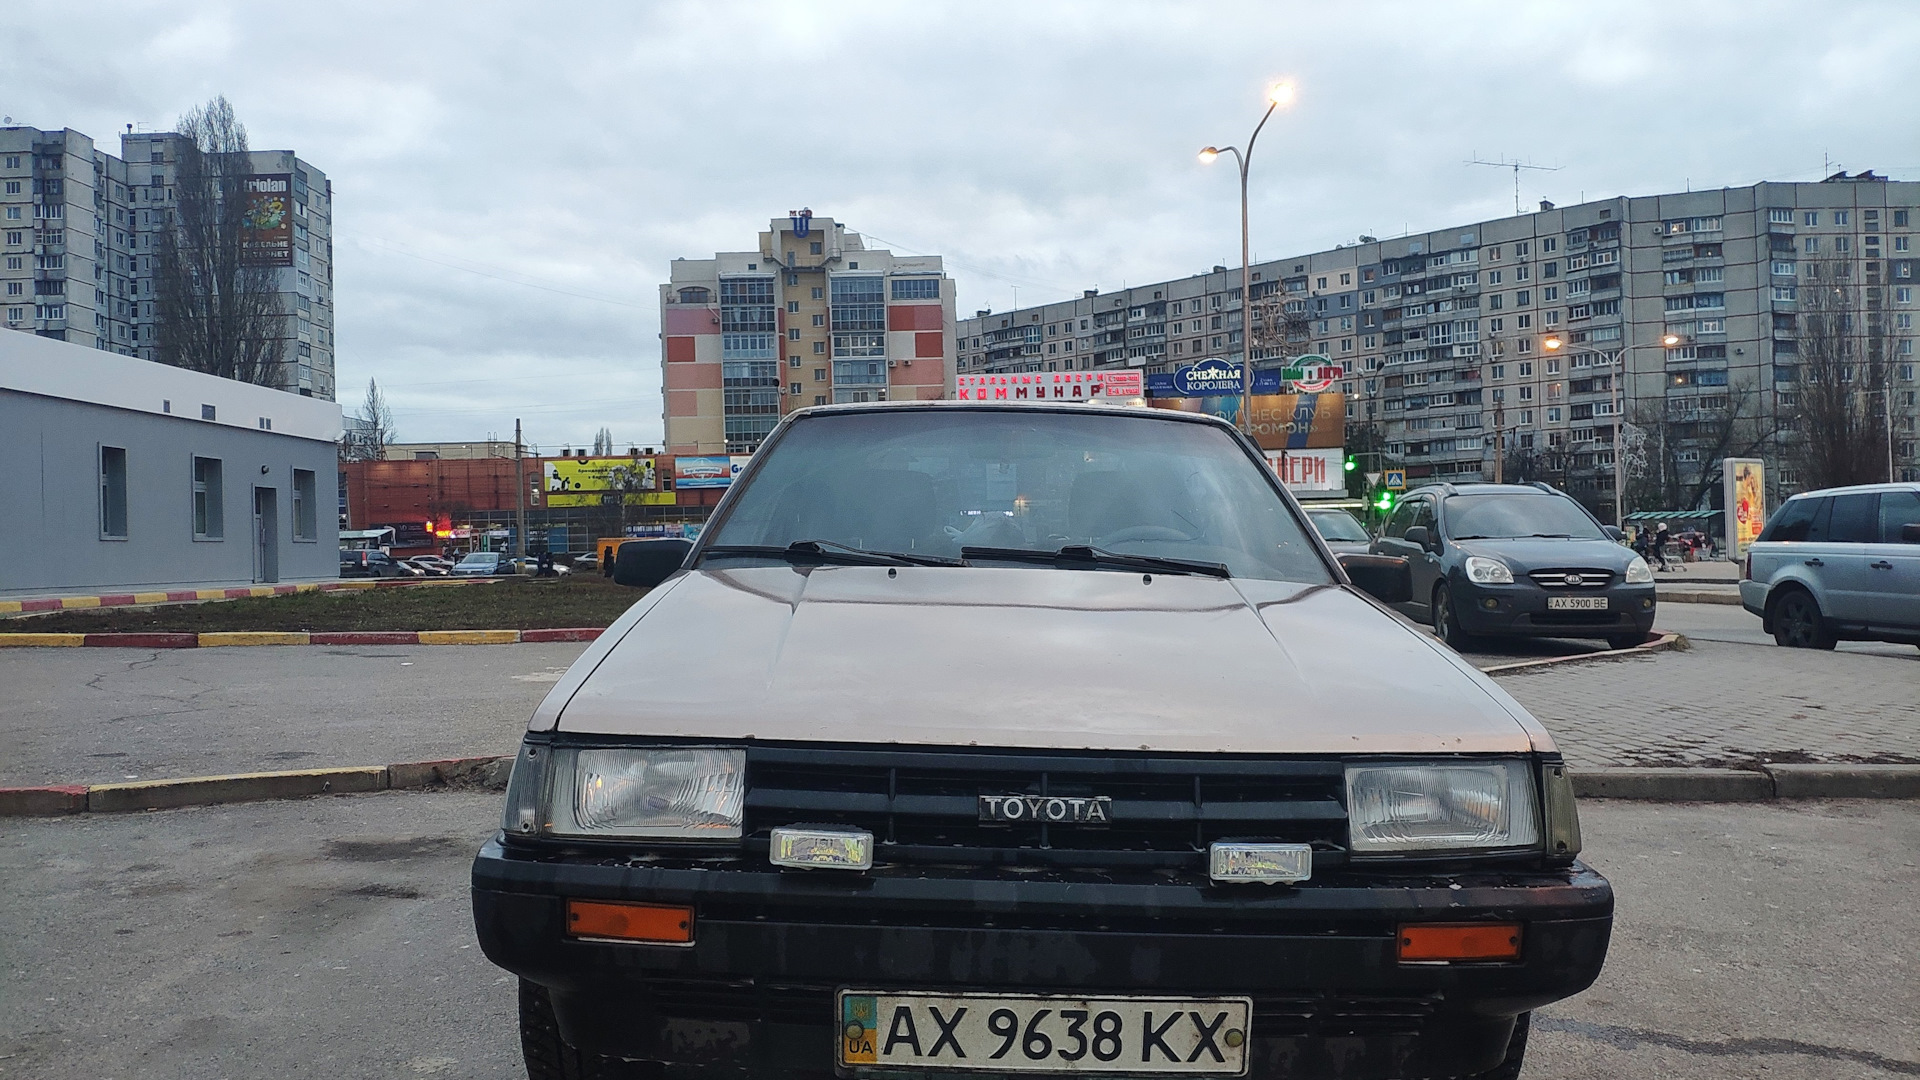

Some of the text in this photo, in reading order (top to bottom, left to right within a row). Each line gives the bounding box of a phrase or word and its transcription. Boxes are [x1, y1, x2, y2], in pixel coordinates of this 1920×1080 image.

[242, 241, 289, 249] КБЕЛЬНЕ
[958, 374, 1043, 386] СТАЛЬНЫЕ
[1053, 373, 1104, 384] ДВЕРИ
[1185, 366, 1241, 381] СНЕЖНАЯ
[958, 384, 1102, 400] КОММУНАР
[1186, 380, 1241, 391] КОРОЛЕВА
[1214, 406, 1331, 422] ФИНЕС КЛУБ
[1554, 599, 1607, 608] AX 5900 BE
[985, 798, 1107, 821] TOYOTA
[882, 1005, 1230, 1063] AX 9638 KX
[848, 1039, 874, 1055] UA
